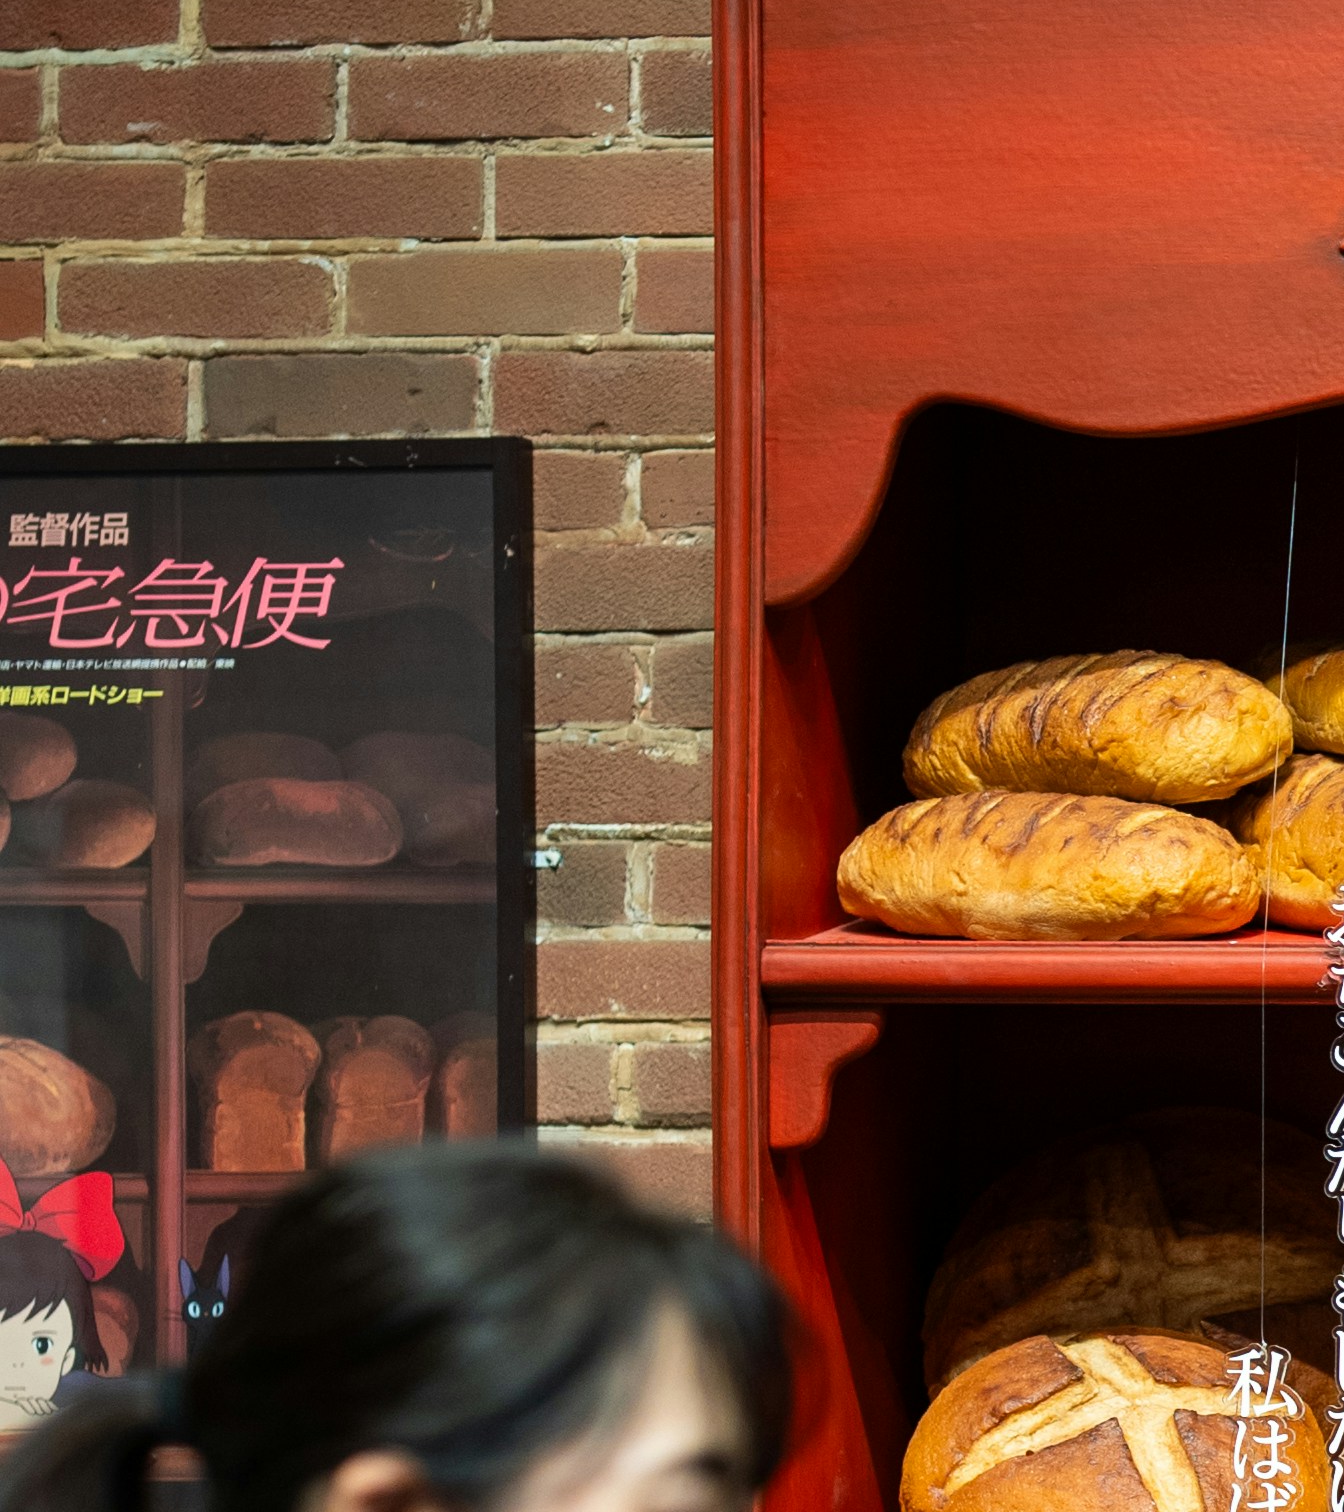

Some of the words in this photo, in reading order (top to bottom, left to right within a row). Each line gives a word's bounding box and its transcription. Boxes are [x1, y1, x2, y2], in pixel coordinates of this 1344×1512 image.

[8, 511, 129, 547] 監督作品
[0, 557, 345, 649] 宅急便
